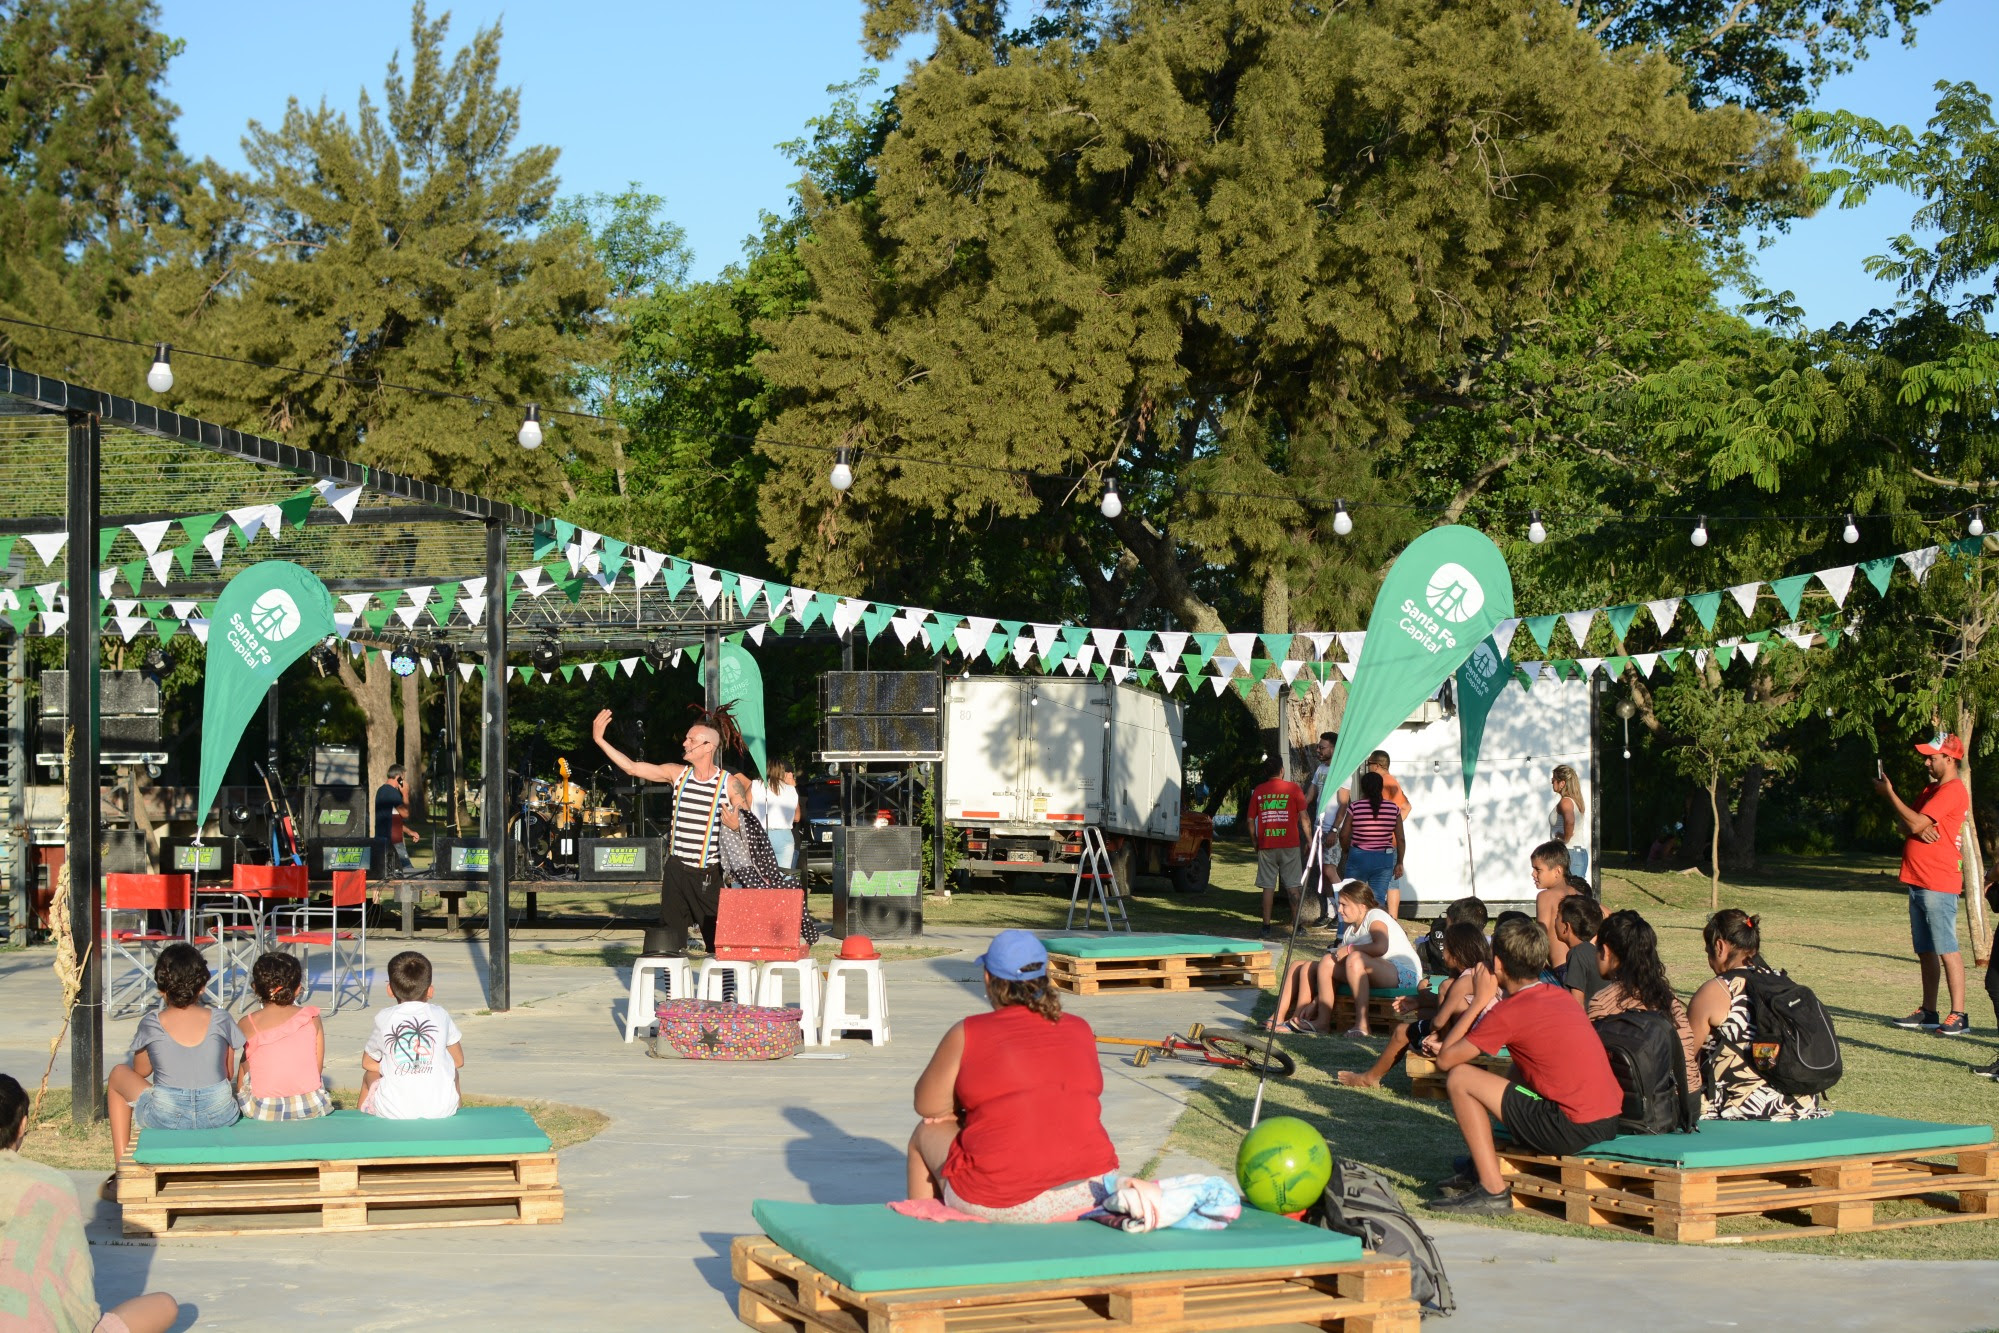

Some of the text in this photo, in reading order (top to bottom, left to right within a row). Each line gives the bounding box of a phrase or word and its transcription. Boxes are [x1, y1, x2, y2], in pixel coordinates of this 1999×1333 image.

[1399, 617, 1443, 655] Capital
[1400, 598, 1457, 649] Santa Fe
[227, 630, 260, 670] Capital
[229, 612, 272, 665] Santa Fe
[1464, 660, 1490, 694] Santa Fe
[1465, 672, 1484, 697] Capital
[959, 710, 972, 721] 80
[318, 809, 352, 825] MG
[1263, 799, 1289, 810] MG
[336, 852, 361, 863] MG
[608, 854, 636, 864] MG
[849, 869, 921, 898] MG
